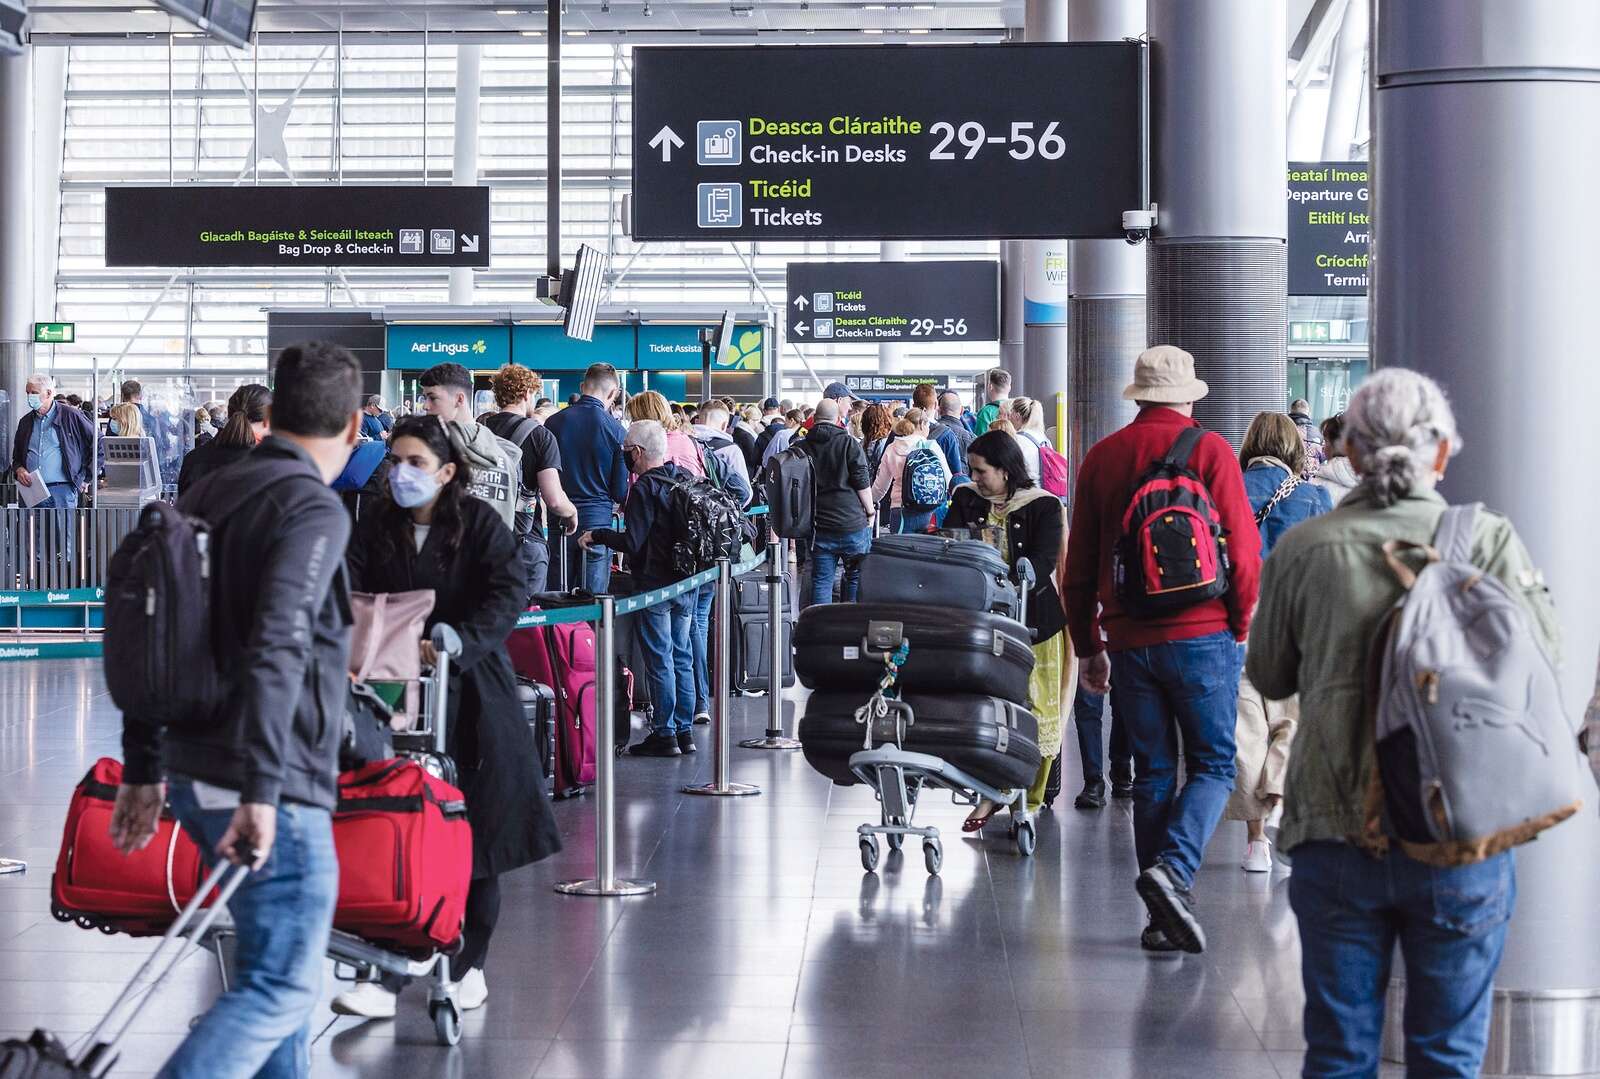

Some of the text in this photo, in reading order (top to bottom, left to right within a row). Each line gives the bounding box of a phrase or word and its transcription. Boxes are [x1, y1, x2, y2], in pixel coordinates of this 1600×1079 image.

[749, 115, 922, 136] Deasca Cláraithe
[749, 143, 907, 164] Check-in Desks
[1331, 168, 1368, 182] Imea
[749, 178, 812, 198] Ticéid
[749, 206, 823, 226] Tickets
[1308, 210, 1345, 225] Eitiltí
[199, 229, 394, 244] Glacadh Bagáiste & Seiceáil Isteach
[278, 242, 394, 257] Bag Drop & Check-in
[1315, 252, 1368, 268] Críochf
[1045, 270, 1067, 281] WiF
[1324, 273, 1368, 287] Termi
[835, 290, 862, 300] Ticéid
[835, 302, 866, 312] Tickets
[835, 316, 908, 326] Deasca Cláraithe
[835, 328, 902, 338] Check-in Desks
[410, 341, 469, 355] Aer Lingus
[649, 344, 674, 353] Ticket
